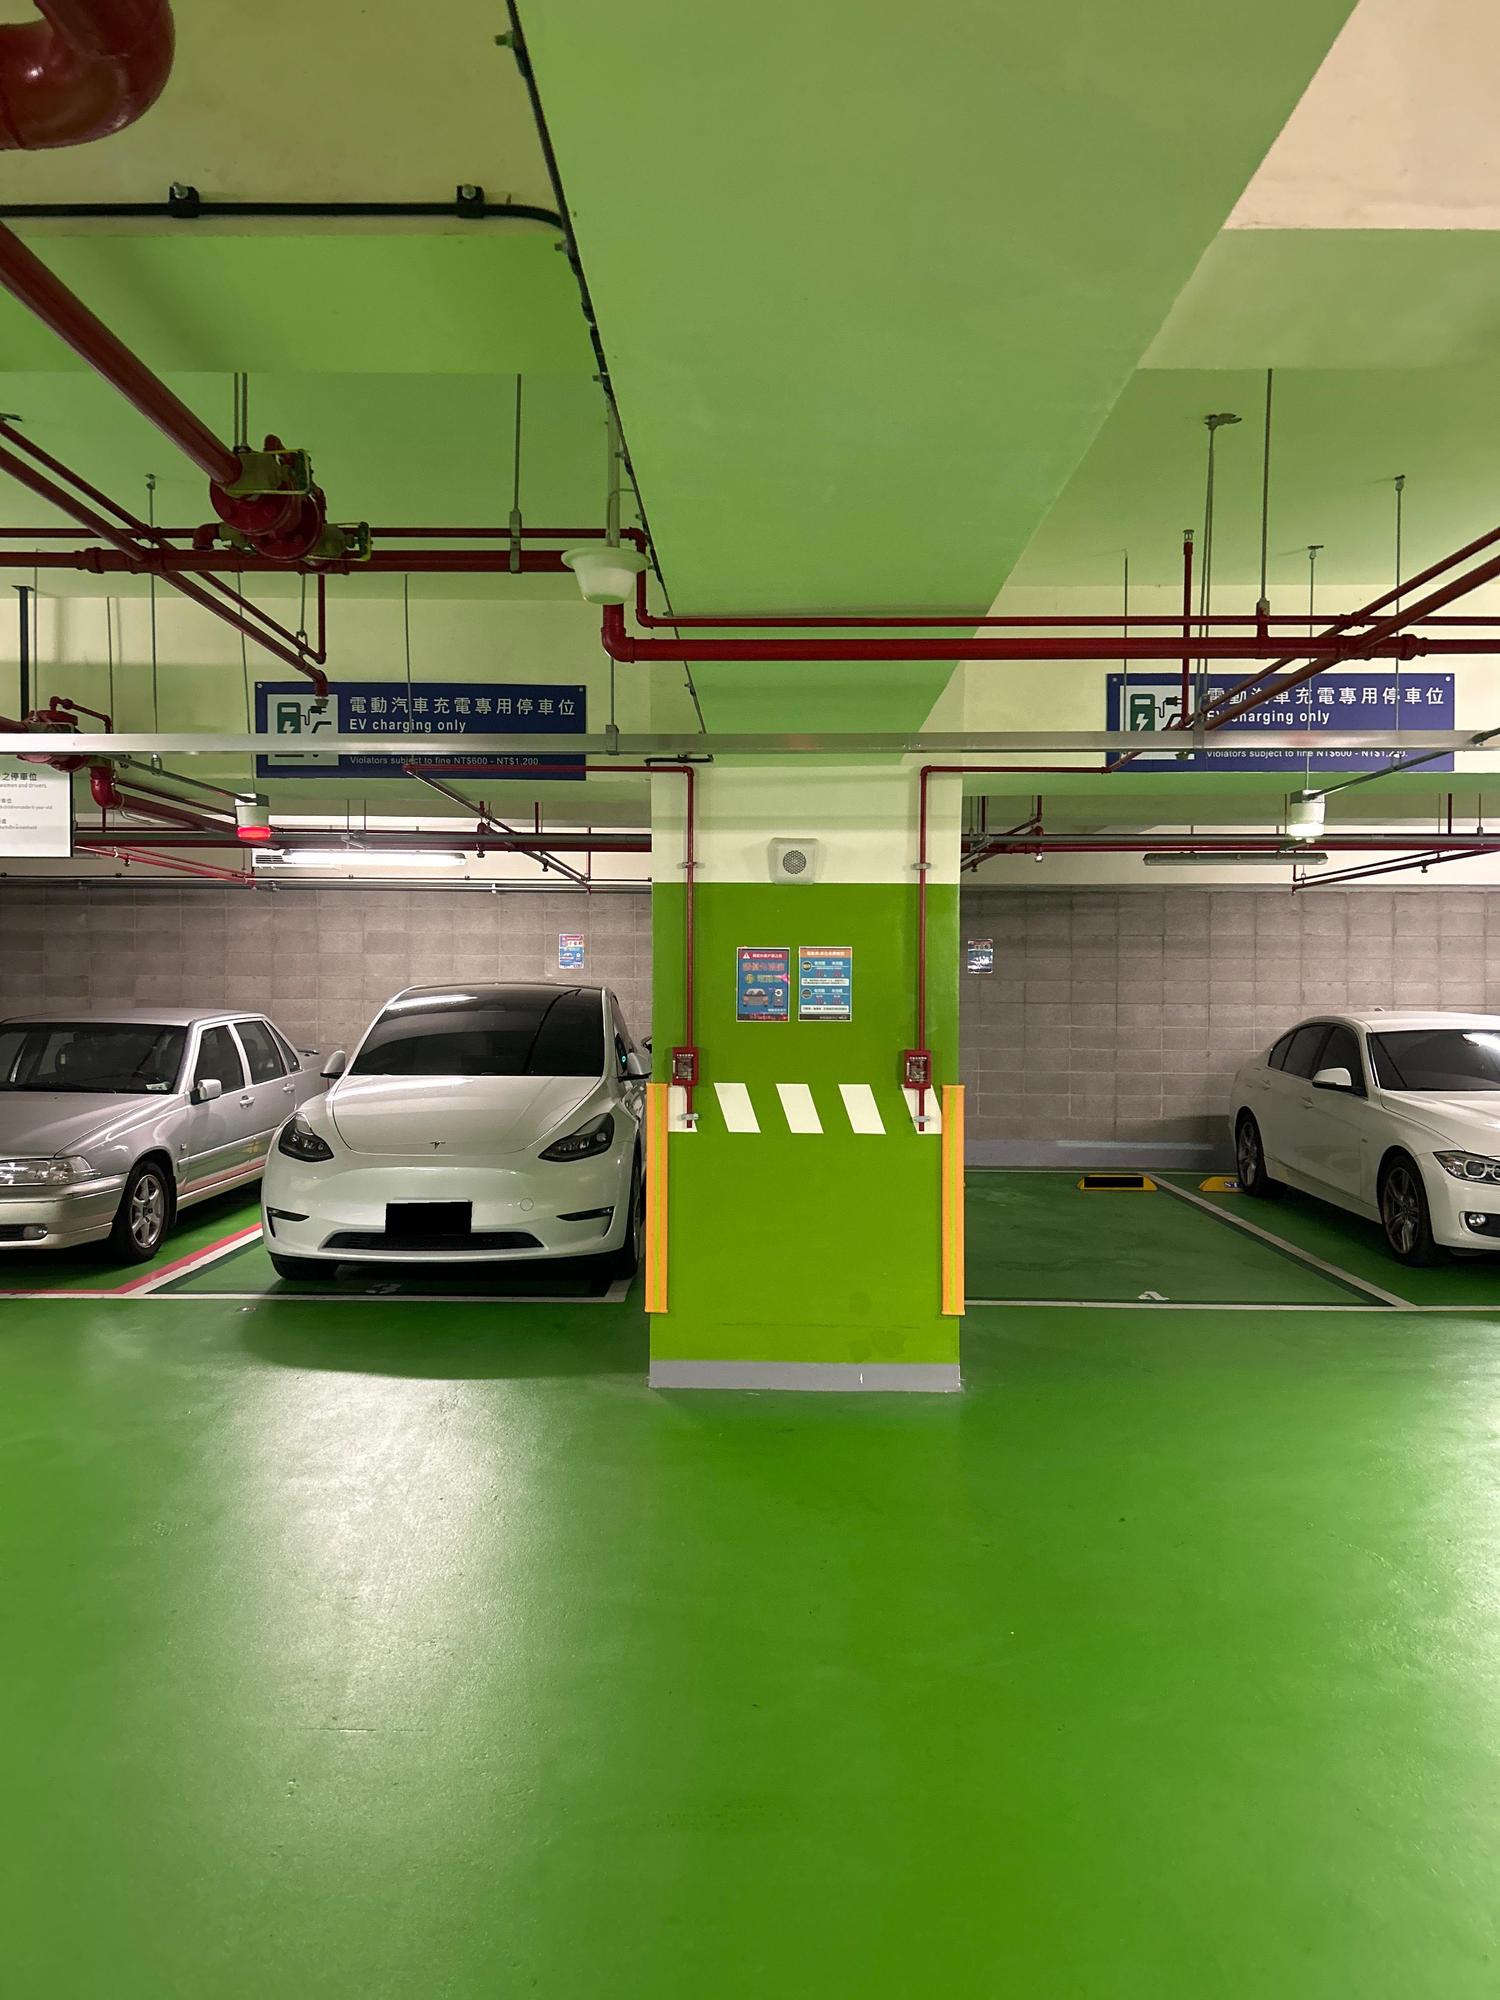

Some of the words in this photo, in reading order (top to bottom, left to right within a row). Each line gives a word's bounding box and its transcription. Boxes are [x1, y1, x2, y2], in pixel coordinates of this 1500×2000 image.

[349, 696, 576, 716] 電動汽車充電專用停車位
[1299, 710, 1330, 725] only
[349, 718, 367, 730] EV
[372, 718, 432, 733] charging
[437, 718, 466, 733] only
[350, 756, 388, 764] Violators
[424, 756, 433, 764] to
[435, 756, 451, 764] fine
[454, 756, 488, 765] NT$600
